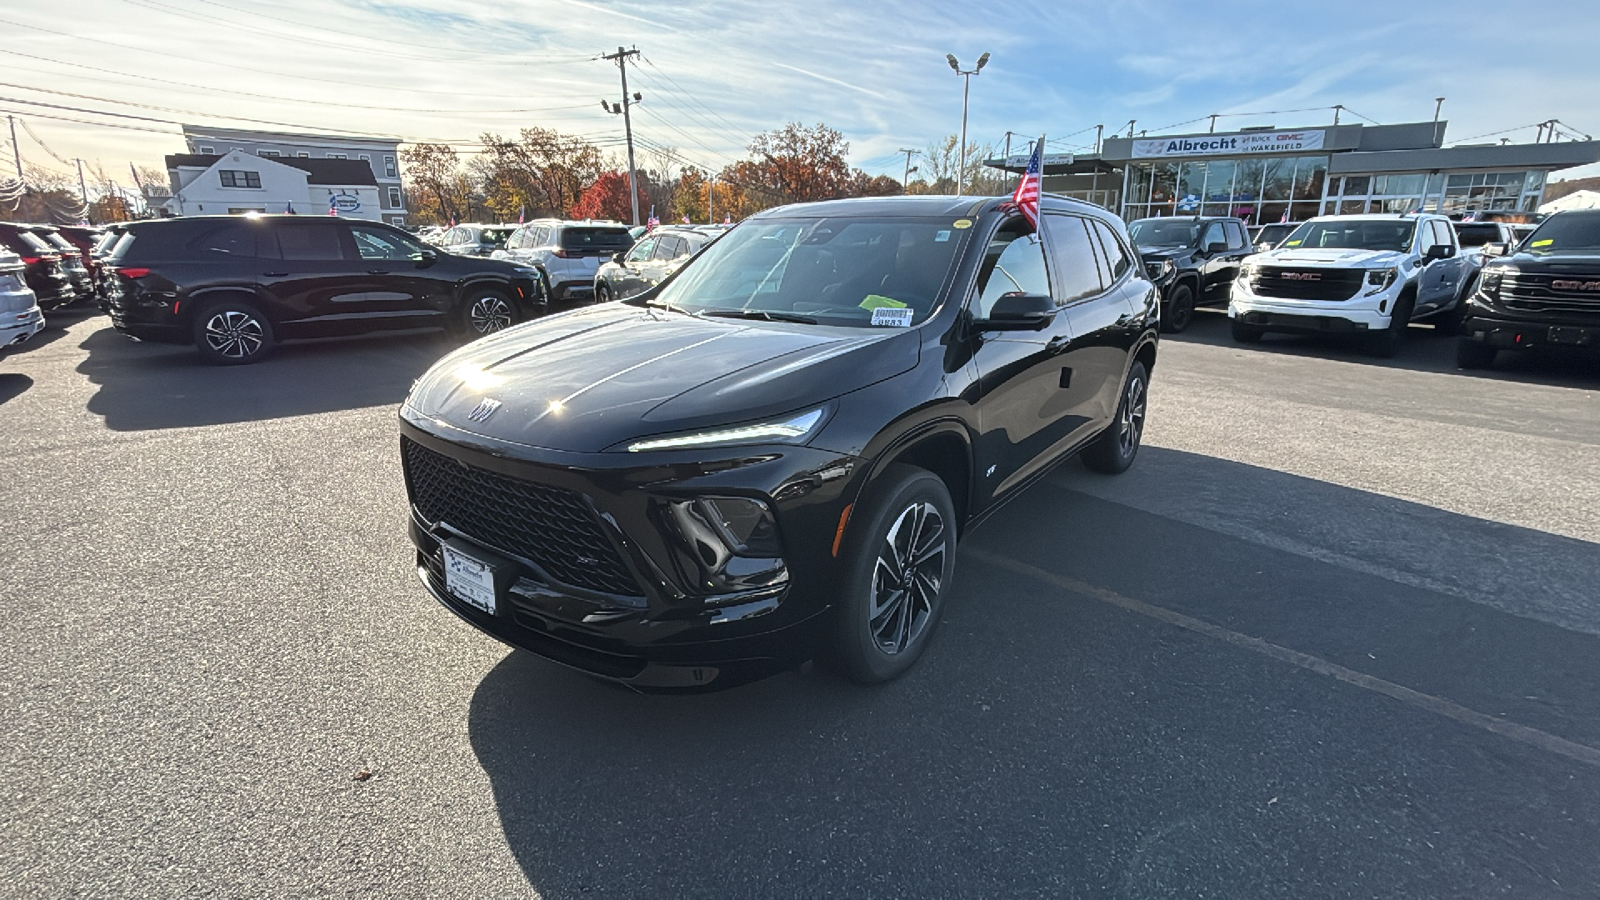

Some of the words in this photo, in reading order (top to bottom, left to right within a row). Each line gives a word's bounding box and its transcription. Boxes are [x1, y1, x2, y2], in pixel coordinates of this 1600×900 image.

[1166, 138, 1237, 152] Albrecht
[1251, 143, 1302, 151] WAKEFIELD
[1281, 272, 1321, 280] GMC
[1552, 280, 1600, 290] GM
